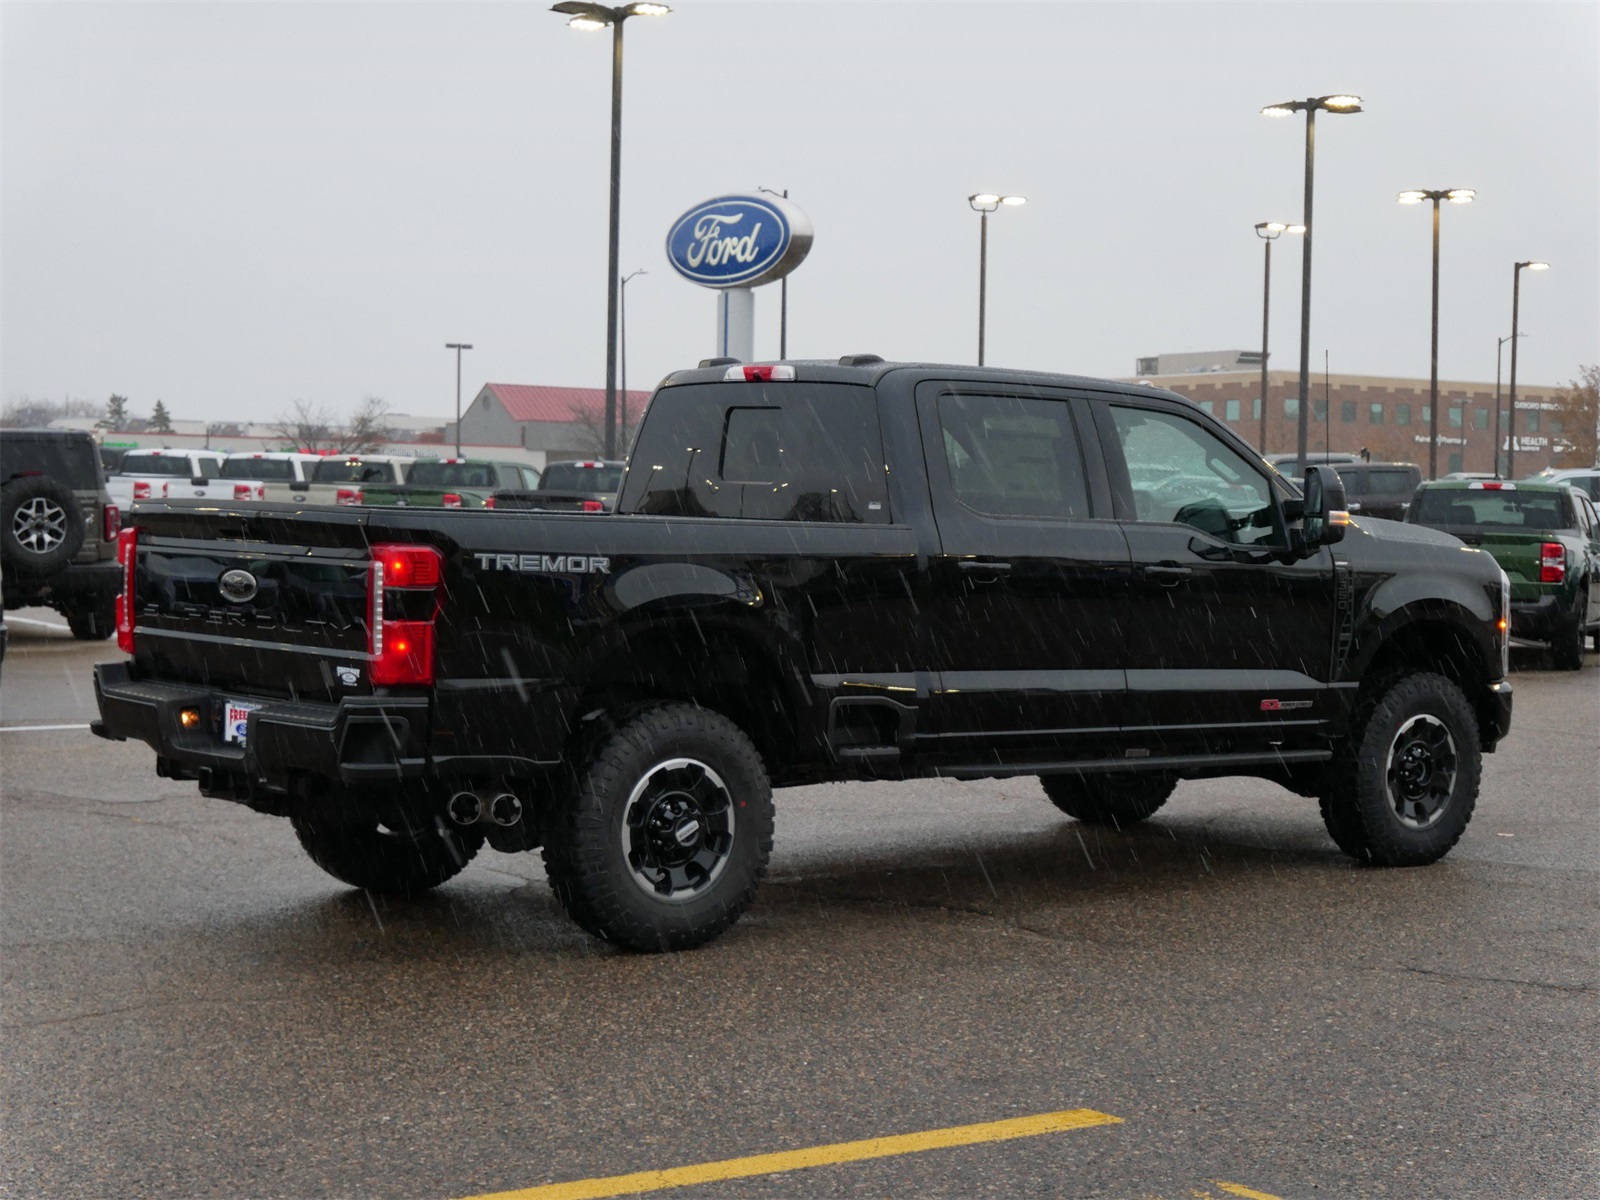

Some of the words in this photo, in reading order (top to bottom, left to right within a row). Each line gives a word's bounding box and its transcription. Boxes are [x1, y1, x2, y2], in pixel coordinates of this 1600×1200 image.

[687, 213, 762, 267] Ford
[1521, 437, 1548, 446] HEALTH
[474, 552, 611, 574] TREMOR
